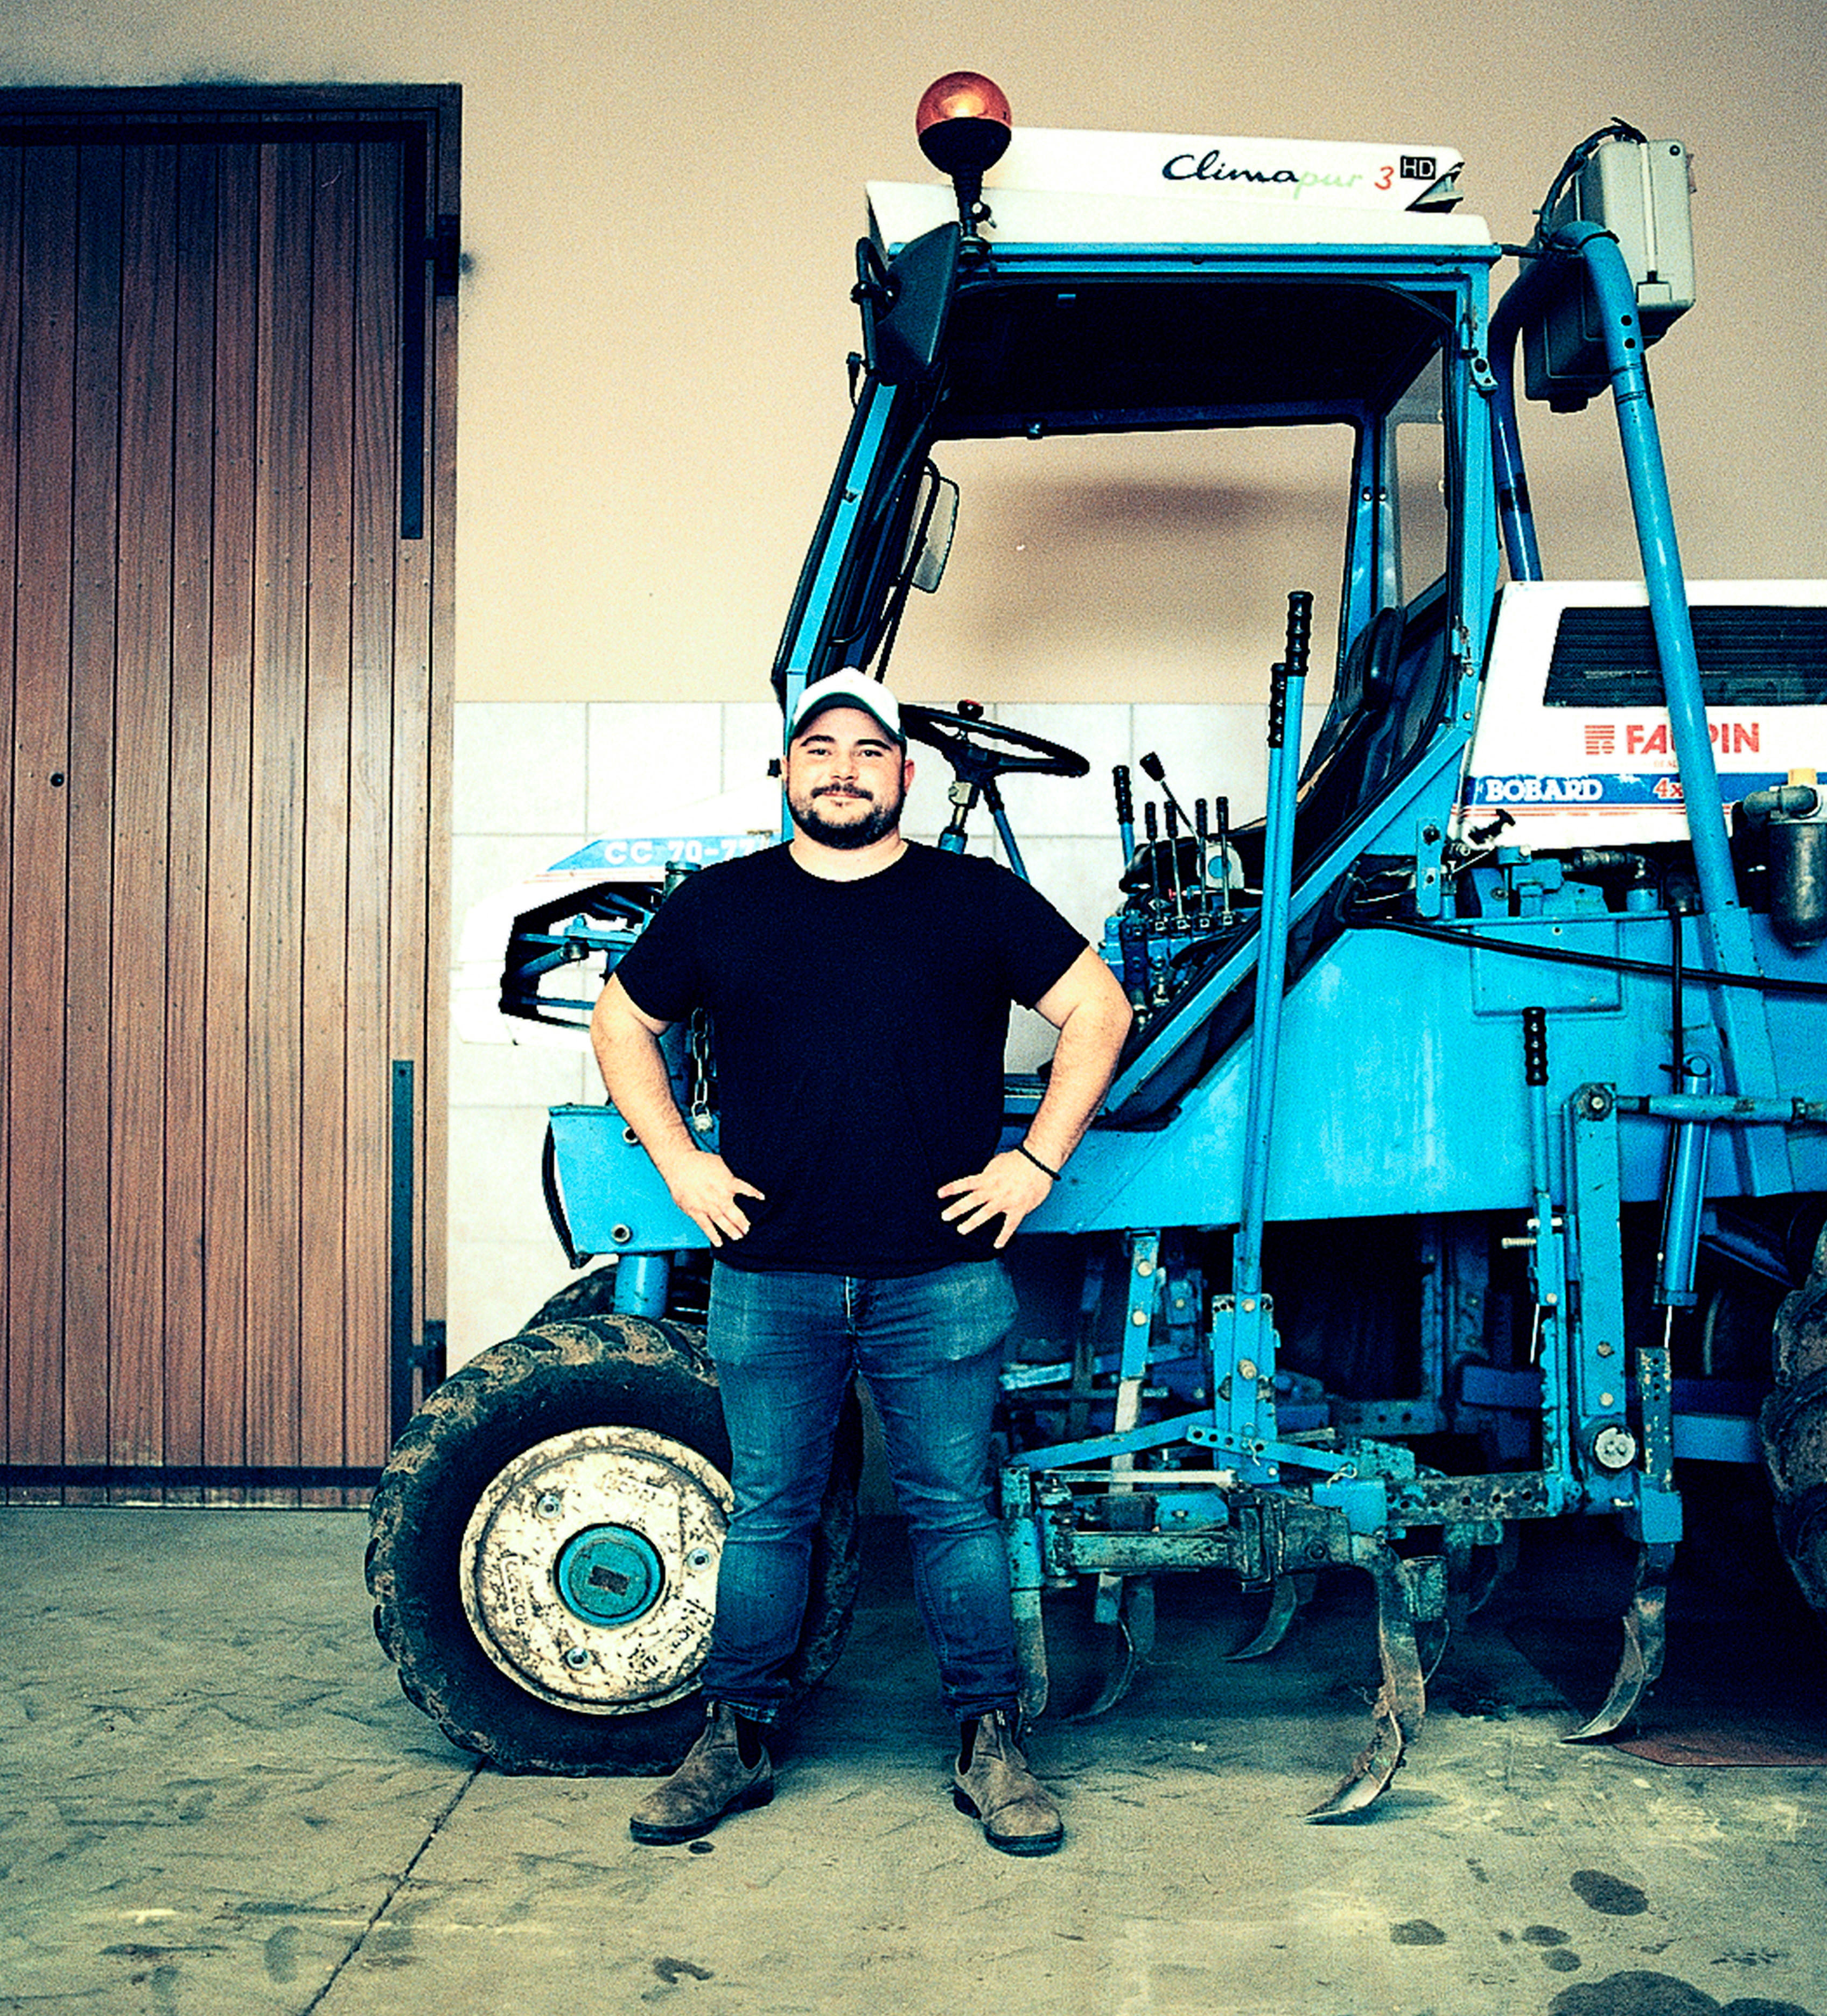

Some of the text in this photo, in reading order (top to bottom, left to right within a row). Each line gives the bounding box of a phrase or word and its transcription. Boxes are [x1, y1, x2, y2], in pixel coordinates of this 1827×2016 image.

[1161, 149, 1436, 200] Climapur 3 HD
[1626, 723, 1760, 755] FAIN
[1486, 777, 1684, 801] BOBARD 4x
[604, 841, 653, 864] CC
